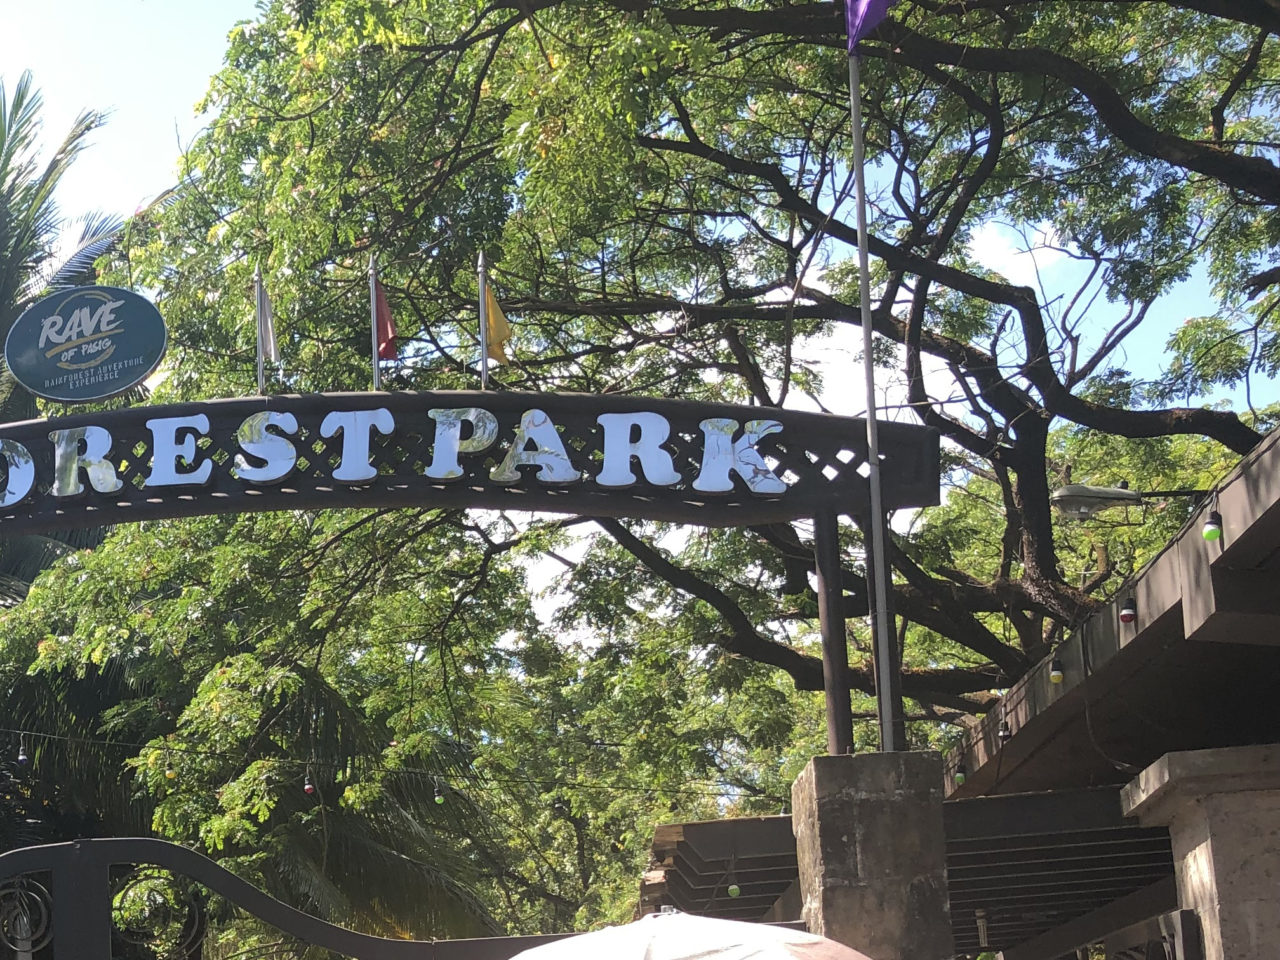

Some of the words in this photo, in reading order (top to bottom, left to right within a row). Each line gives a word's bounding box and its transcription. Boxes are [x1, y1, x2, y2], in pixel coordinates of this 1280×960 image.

[39, 300, 125, 349] RAVE
[61, 348, 77, 362] OF
[81, 338, 112, 356] PASIG
[69, 371, 119, 390] EXPERIENCE
[425, 408, 788, 498] PARK
